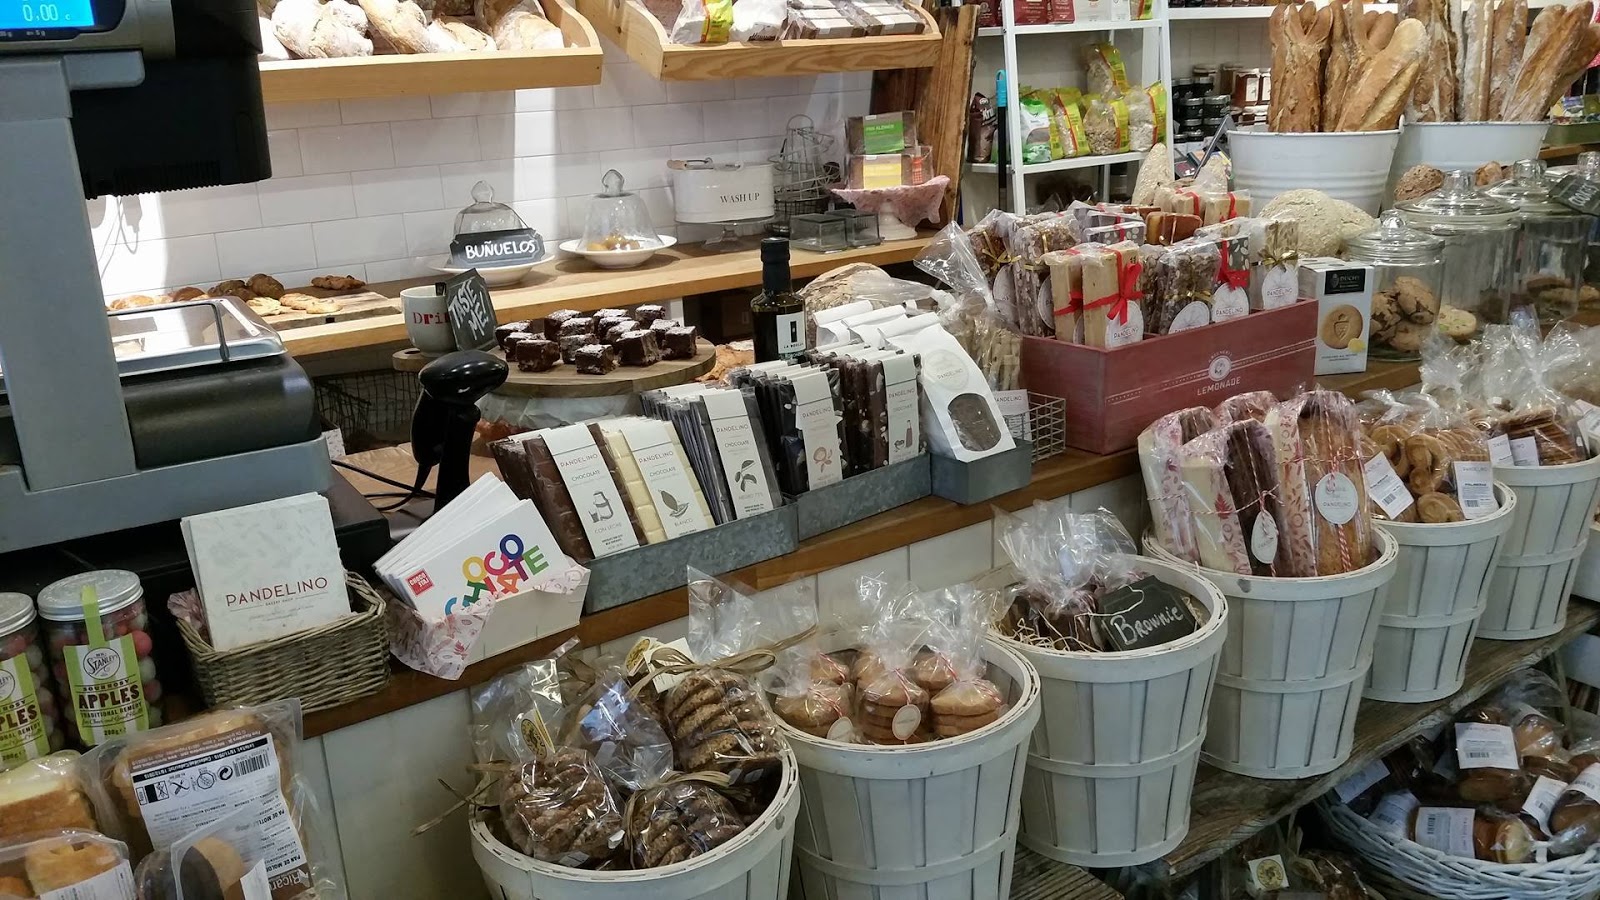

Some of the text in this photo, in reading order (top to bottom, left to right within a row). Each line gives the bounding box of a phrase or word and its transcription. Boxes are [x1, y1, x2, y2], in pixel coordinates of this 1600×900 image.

[720, 192, 760, 203] WASH UP
[465, 240, 536, 259] BUÑUELOS
[448, 279, 477, 330] TASTE
[468, 291, 489, 341] ME!
[1197, 376, 1242, 396] LEMONADE
[802, 406, 832, 418] PANDELINO
[716, 424, 749, 433] PANDELINO
[724, 440, 750, 448] CHOCOLATE
[560, 453, 598, 468] PANDELINO
[638, 450, 674, 463] PANDELINO
[571, 469, 601, 482] CHOCOLATE
[649, 466, 676, 477] CHOCOLATE
[225, 577, 329, 607] PANDELINO
[78, 684, 140, 710] APPLES
[80, 709, 119, 719] TRADITIONAL
[119, 702, 143, 714] REMEDY
[281, 859, 289, 868] DE
[290, 854, 301, 865] PAN
